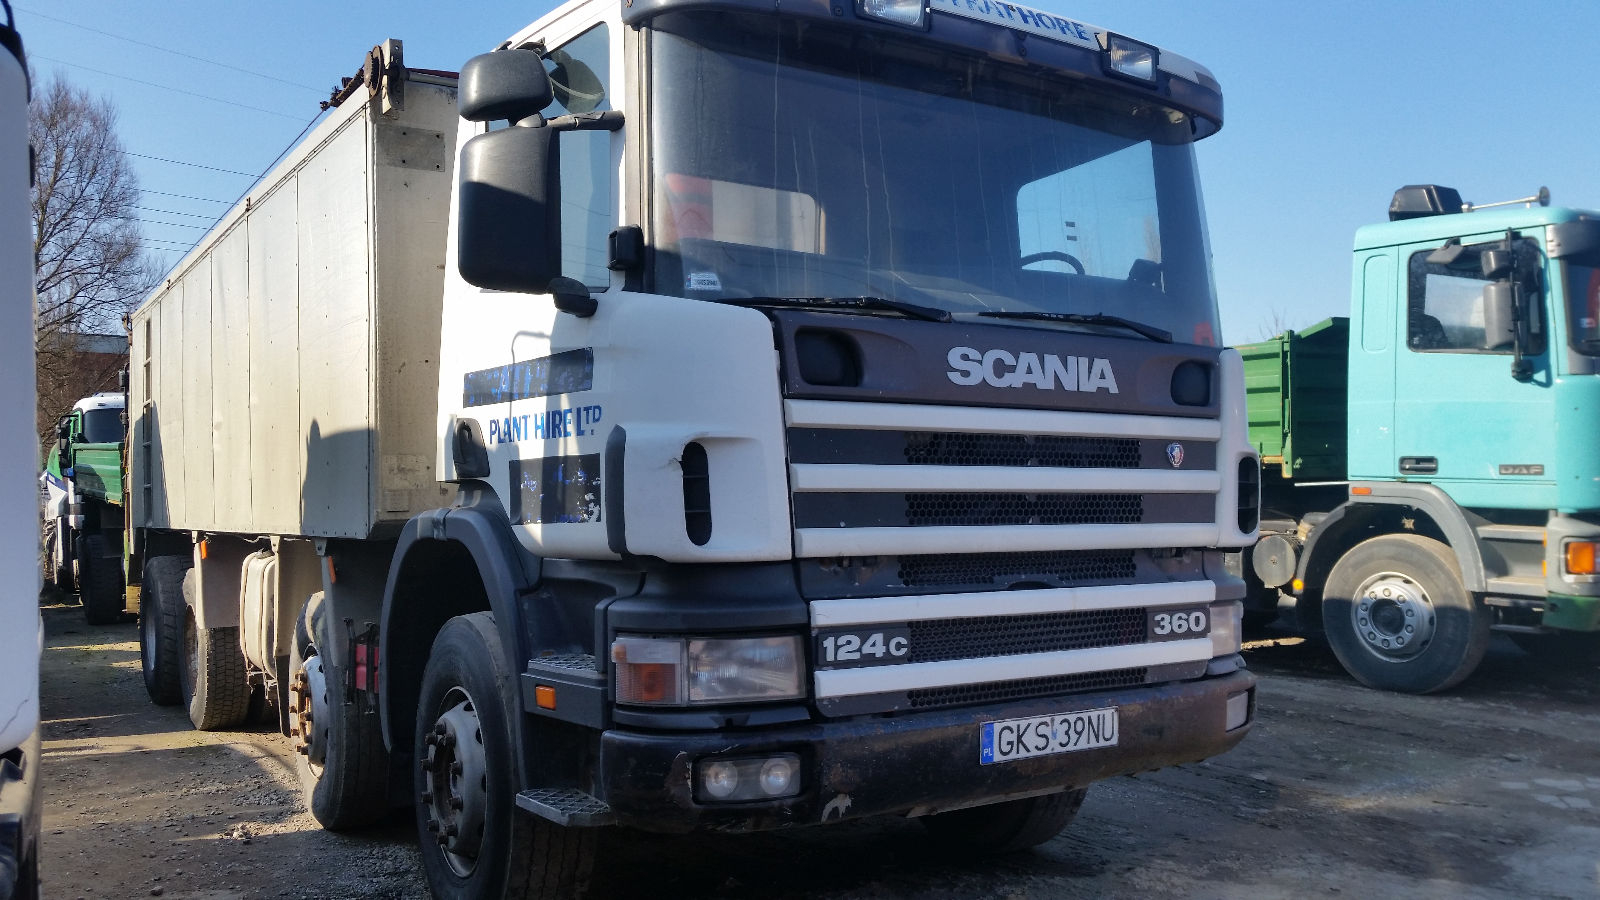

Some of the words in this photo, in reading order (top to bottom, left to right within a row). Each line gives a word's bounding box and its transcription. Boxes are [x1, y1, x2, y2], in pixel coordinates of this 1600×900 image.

[946, 346, 1119, 394] SCANIA
[489, 413, 530, 444] PLANT
[534, 408, 572, 438] HIRE
[1154, 611, 1206, 635] 360
[983, 748, 993, 757] PL
